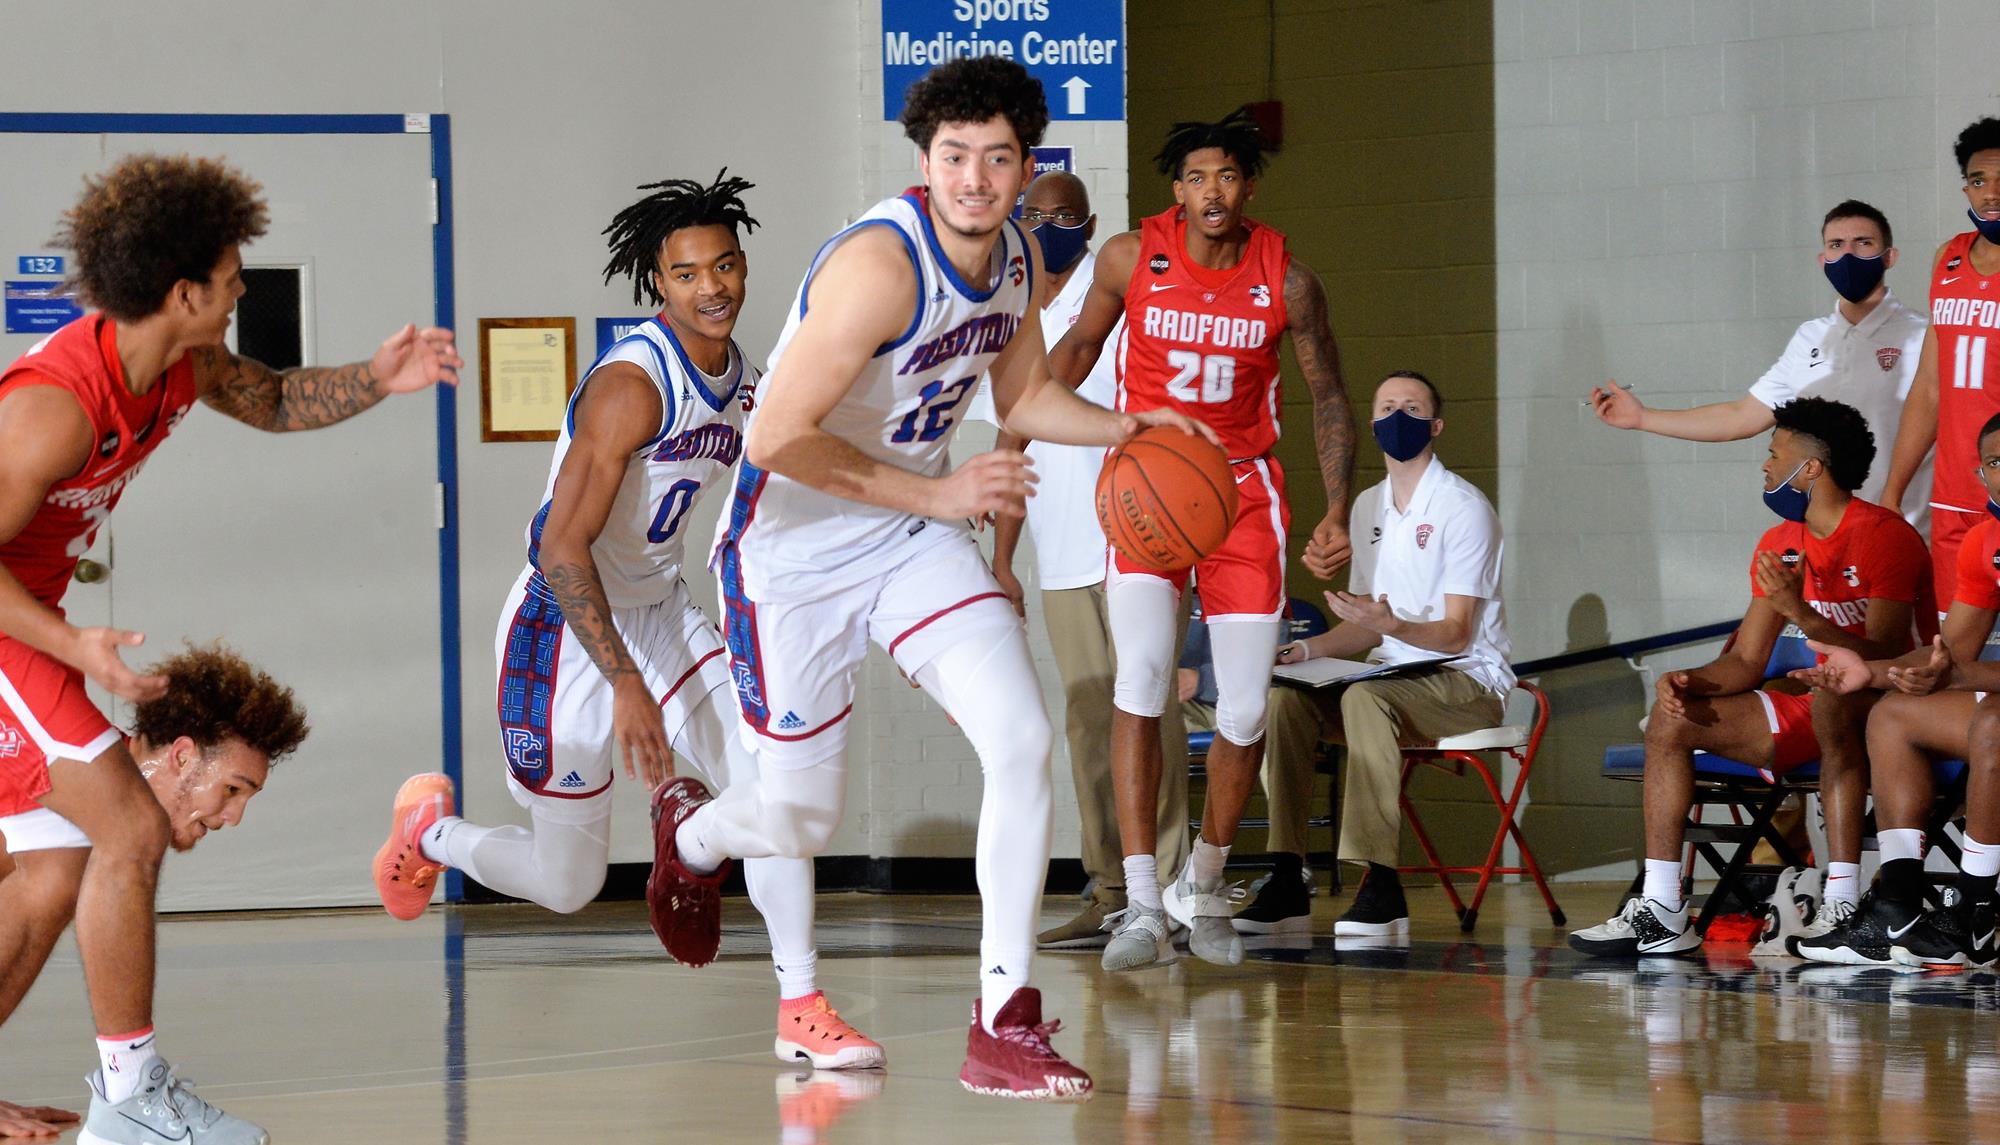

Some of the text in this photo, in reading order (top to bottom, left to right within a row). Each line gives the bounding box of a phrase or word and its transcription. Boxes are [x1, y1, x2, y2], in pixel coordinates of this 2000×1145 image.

[954, 0, 1050, 29] Sports
[885, 31, 1117, 66] Medicine Center
[27, 258, 57, 273] 132
[1144, 306, 1267, 349] RADFORD
[1933, 297, 2000, 329] RADFO
[1165, 349, 1236, 404] 20
[1953, 334, 1987, 390] 11
[891, 374, 978, 443] 12
[647, 478, 701, 543] 0
[778, 721, 806, 729] adidas
[507, 728, 542, 769] PC
